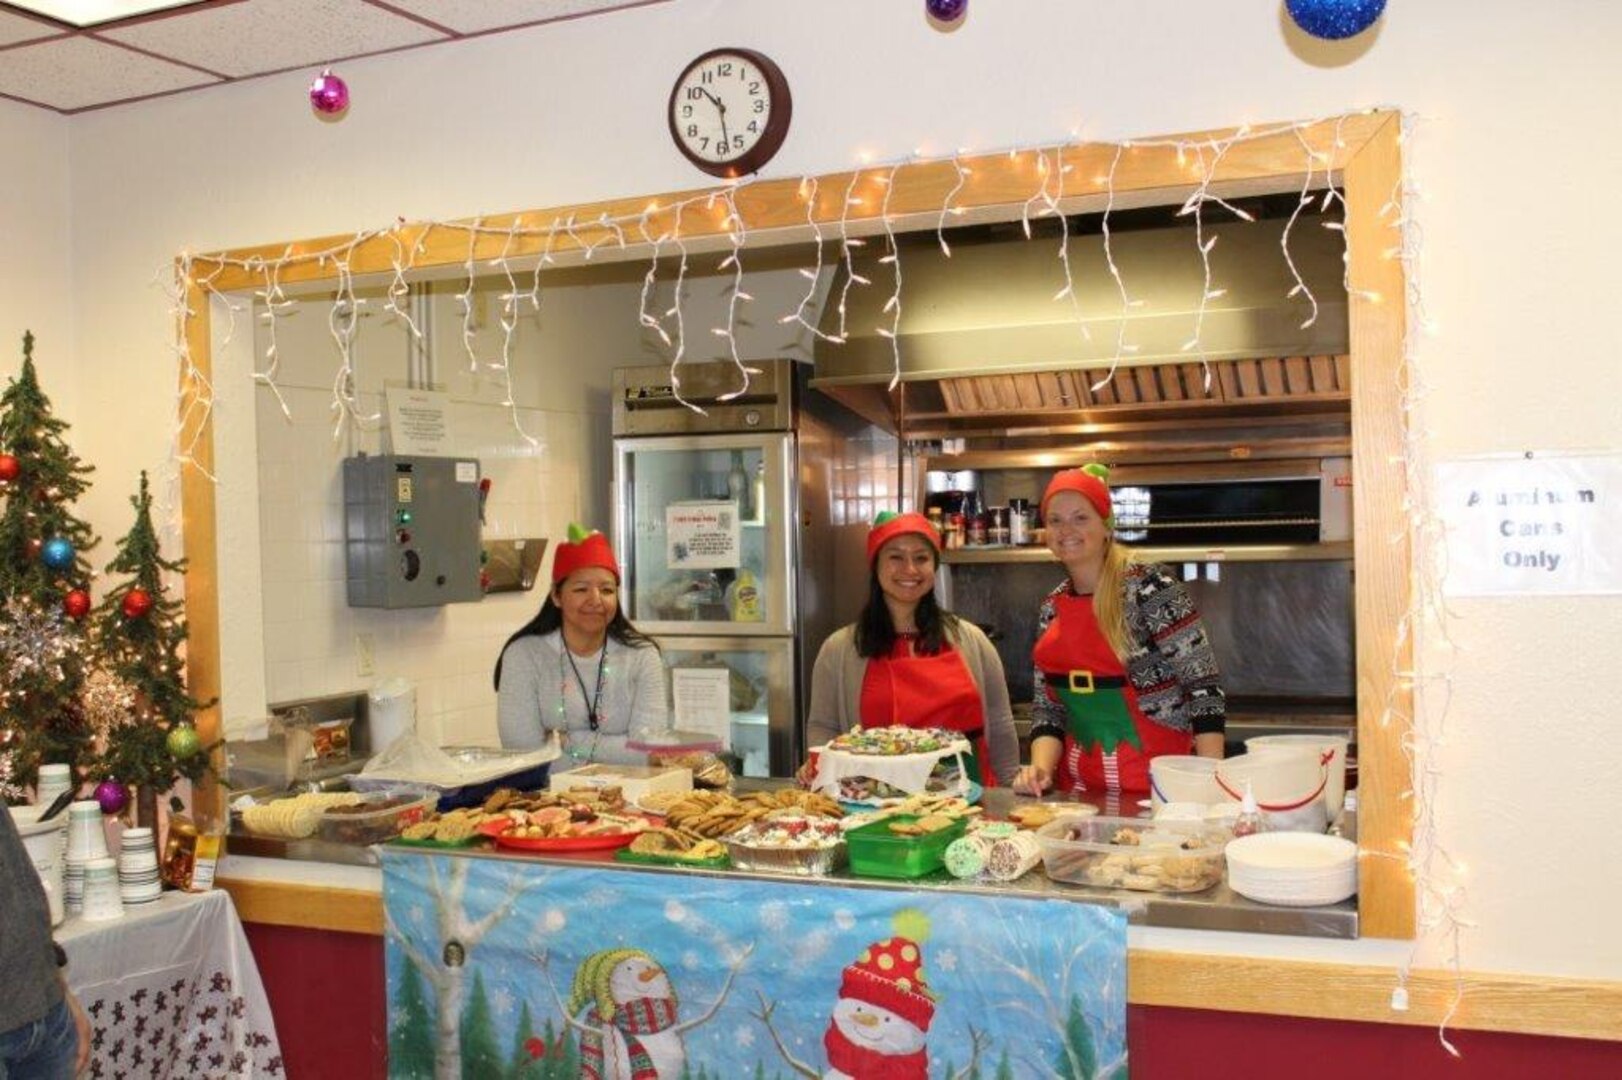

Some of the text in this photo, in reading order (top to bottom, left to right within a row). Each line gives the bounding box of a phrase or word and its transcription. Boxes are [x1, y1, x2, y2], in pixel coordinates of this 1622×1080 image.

[717, 63, 732, 77] 12
[702, 70, 712, 84] 11
[687, 87, 702, 100] 10
[749, 82, 759, 95] 2
[682, 105, 693, 118] 9
[753, 99, 764, 113] 3
[687, 124, 698, 137] 8
[747, 120, 757, 133] 4
[700, 137, 709, 150] 7
[716, 141, 727, 155] 6
[733, 135, 744, 148] 5
[1502, 549, 1562, 572] Only
